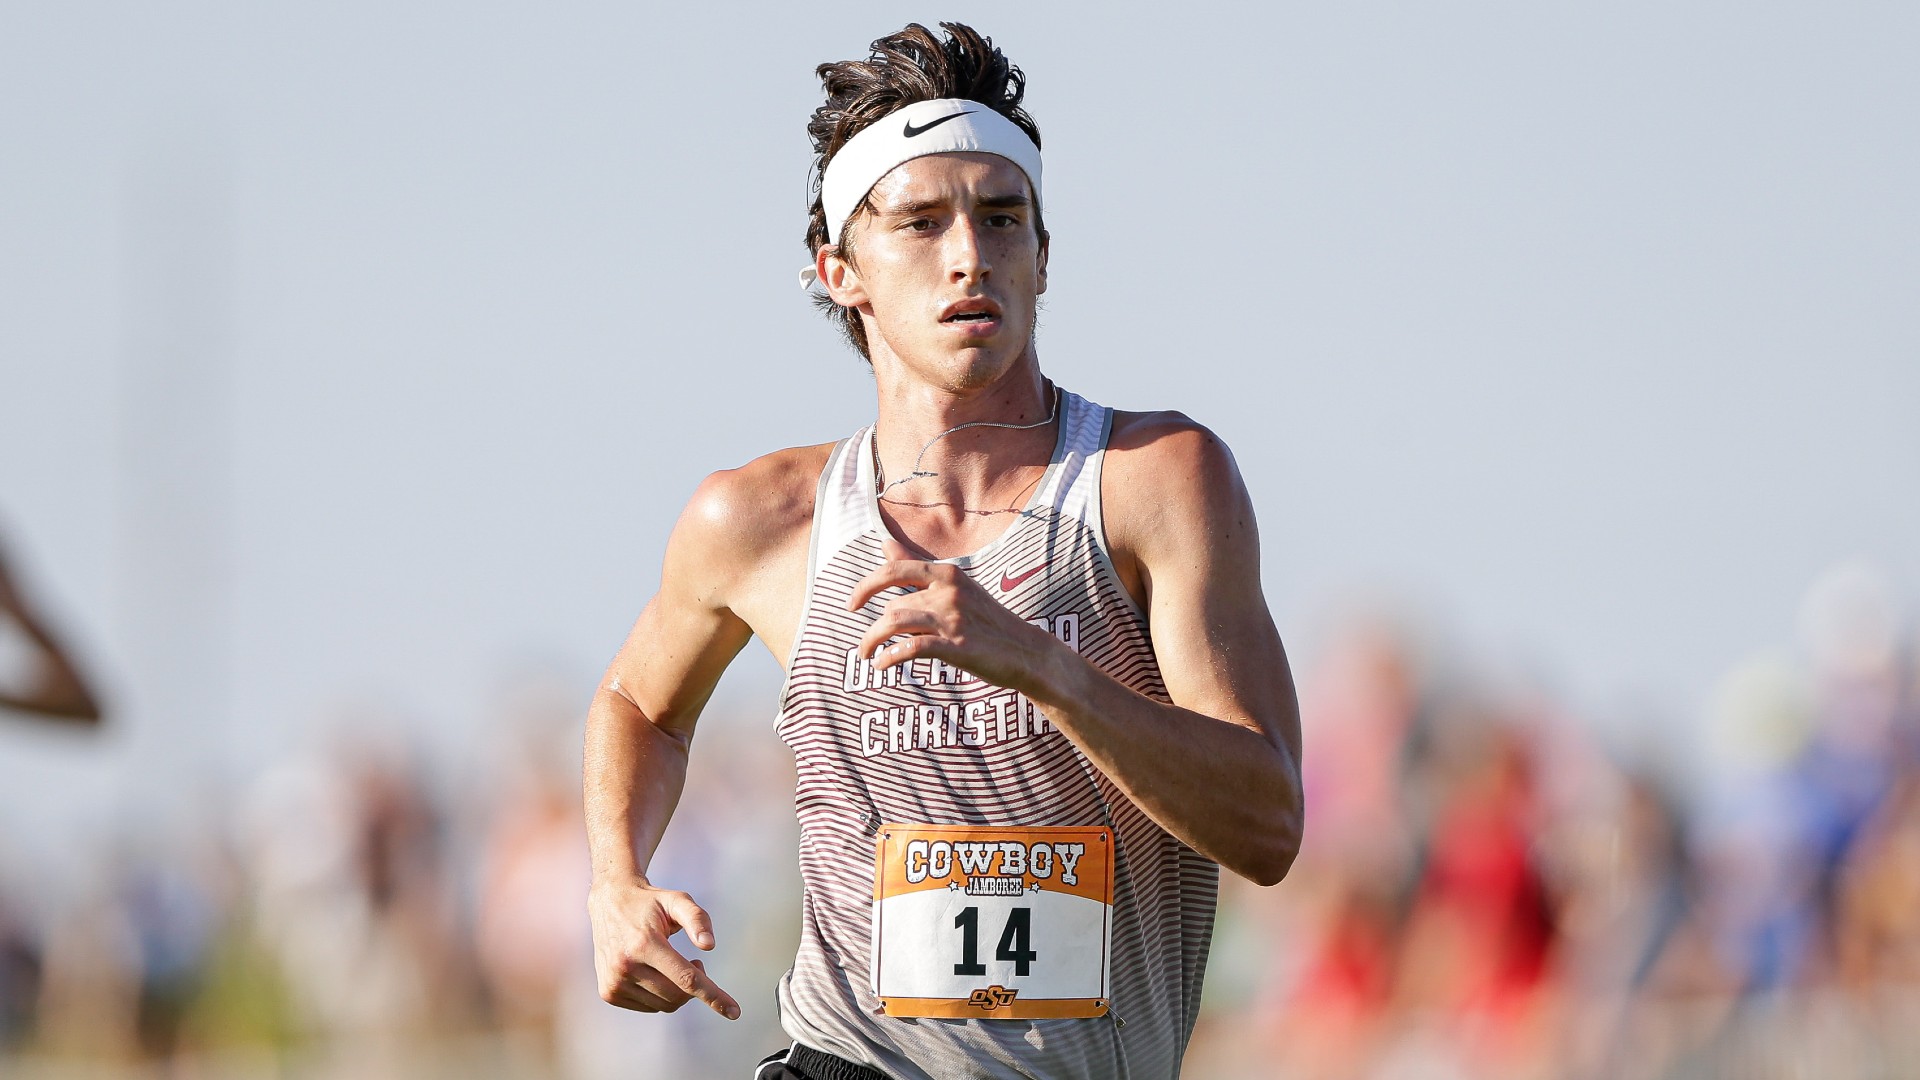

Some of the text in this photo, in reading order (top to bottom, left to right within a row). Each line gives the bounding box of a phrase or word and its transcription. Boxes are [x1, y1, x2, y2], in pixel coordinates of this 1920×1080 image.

[906, 840, 1084, 886] COWBOY
[965, 876, 1024, 896] JAMBOREE
[954, 906, 1037, 977] 14
[968, 985, 1019, 1010] OSU
